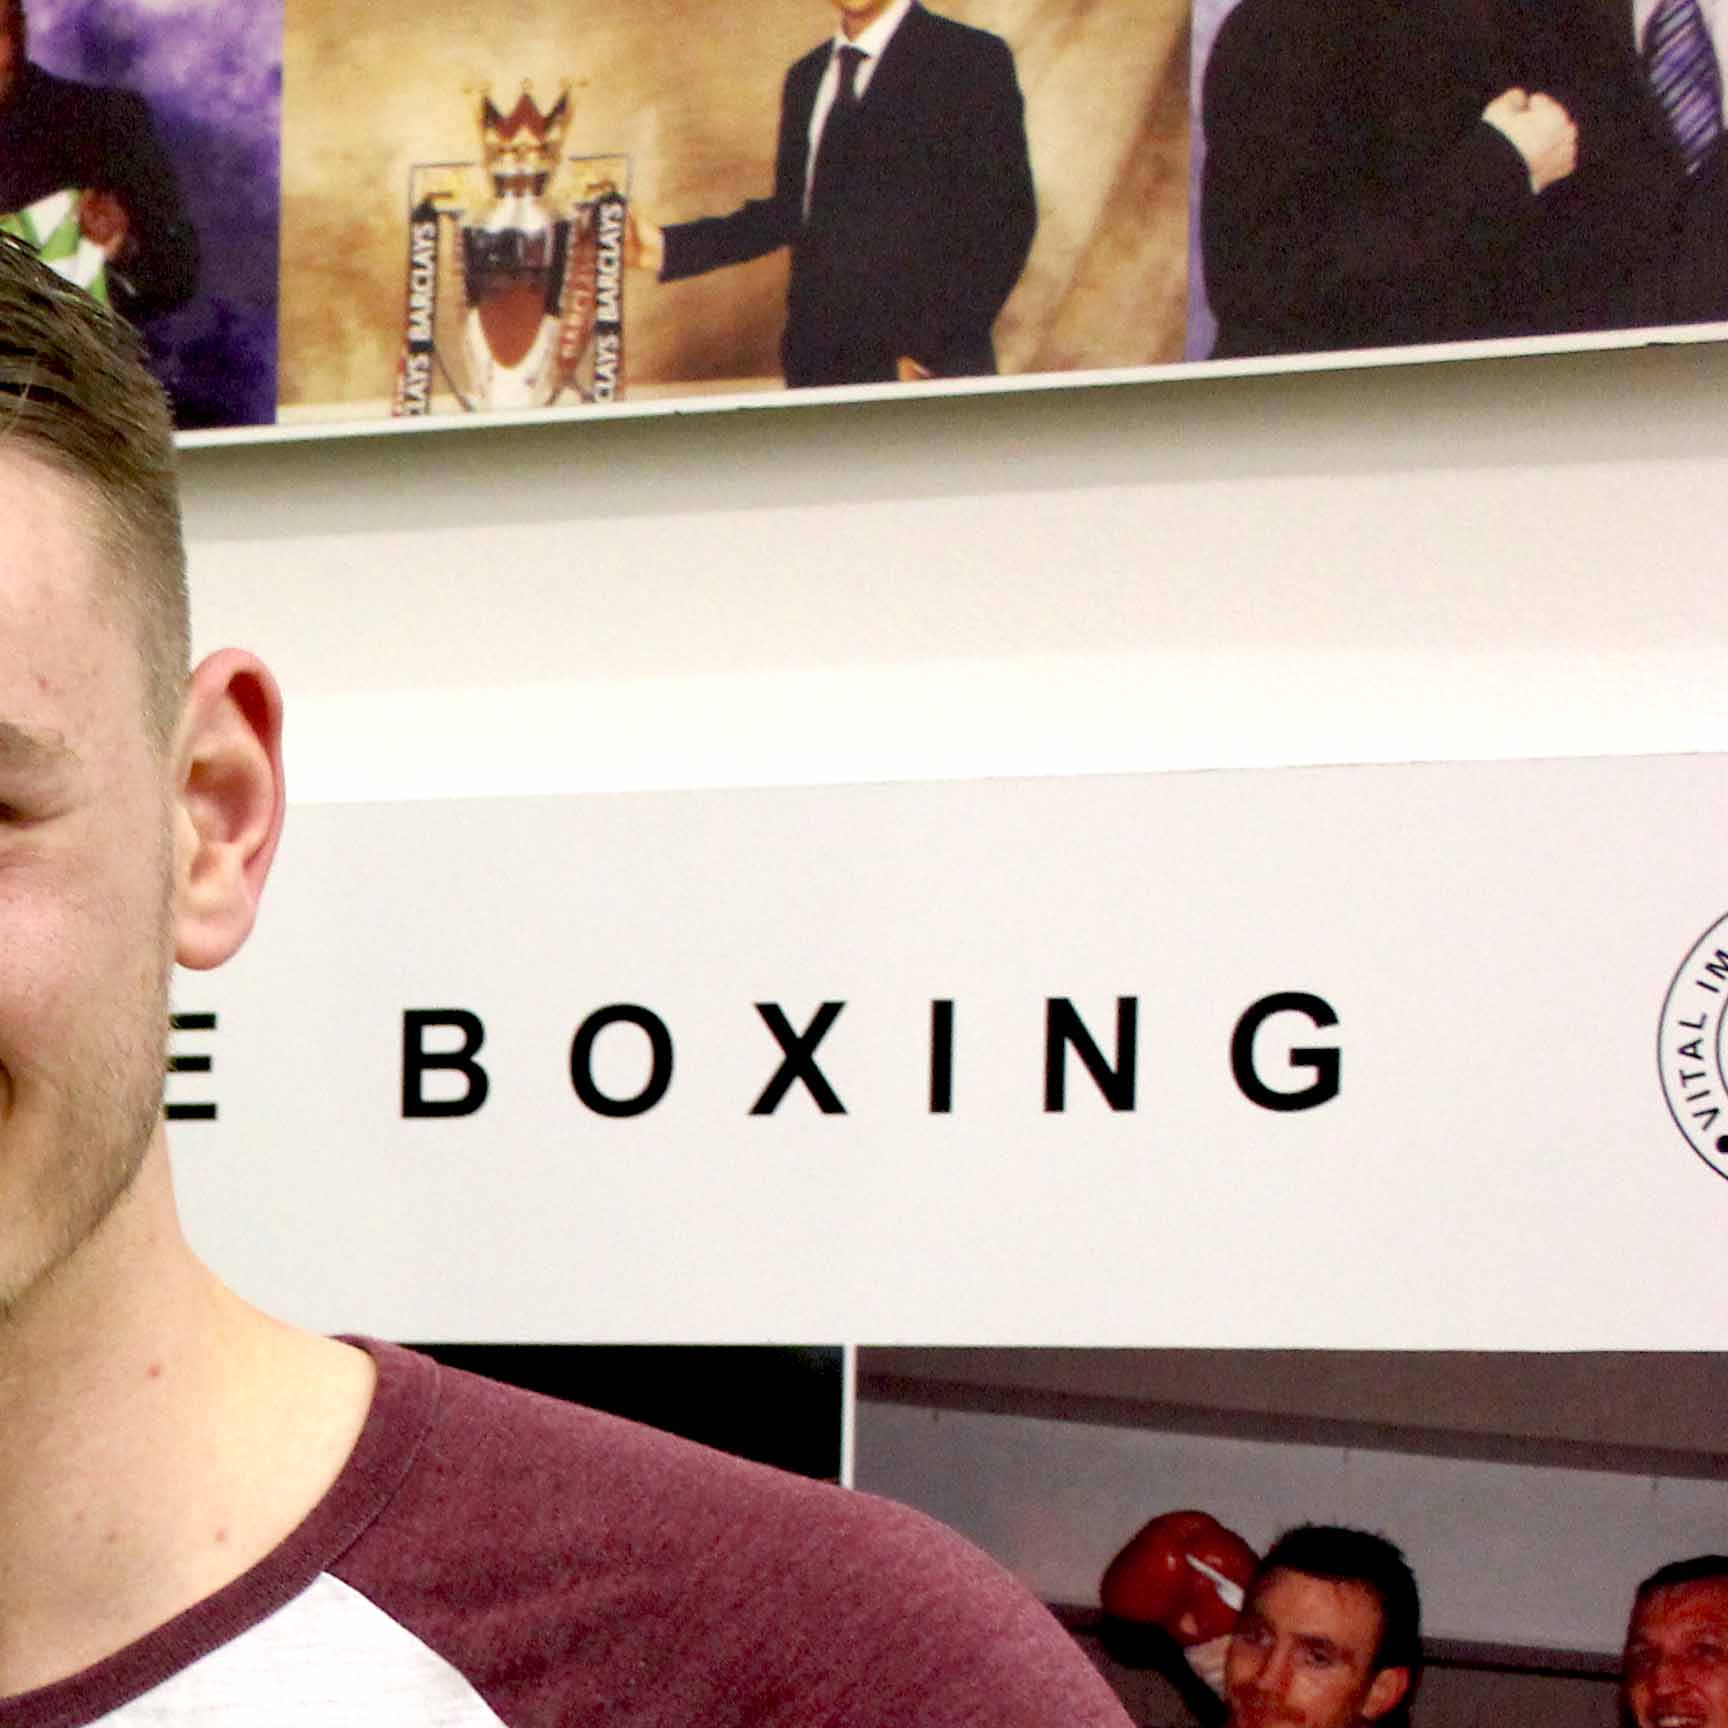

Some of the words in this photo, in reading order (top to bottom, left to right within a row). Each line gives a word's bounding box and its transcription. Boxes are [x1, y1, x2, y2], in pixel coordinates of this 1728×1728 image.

[408, 222, 436, 341] BARCLAYS
[596, 201, 624, 323] BARCLAYS
[400, 991, 1342, 1119] BOXING
[1678, 1013, 1720, 1131] VITAL
